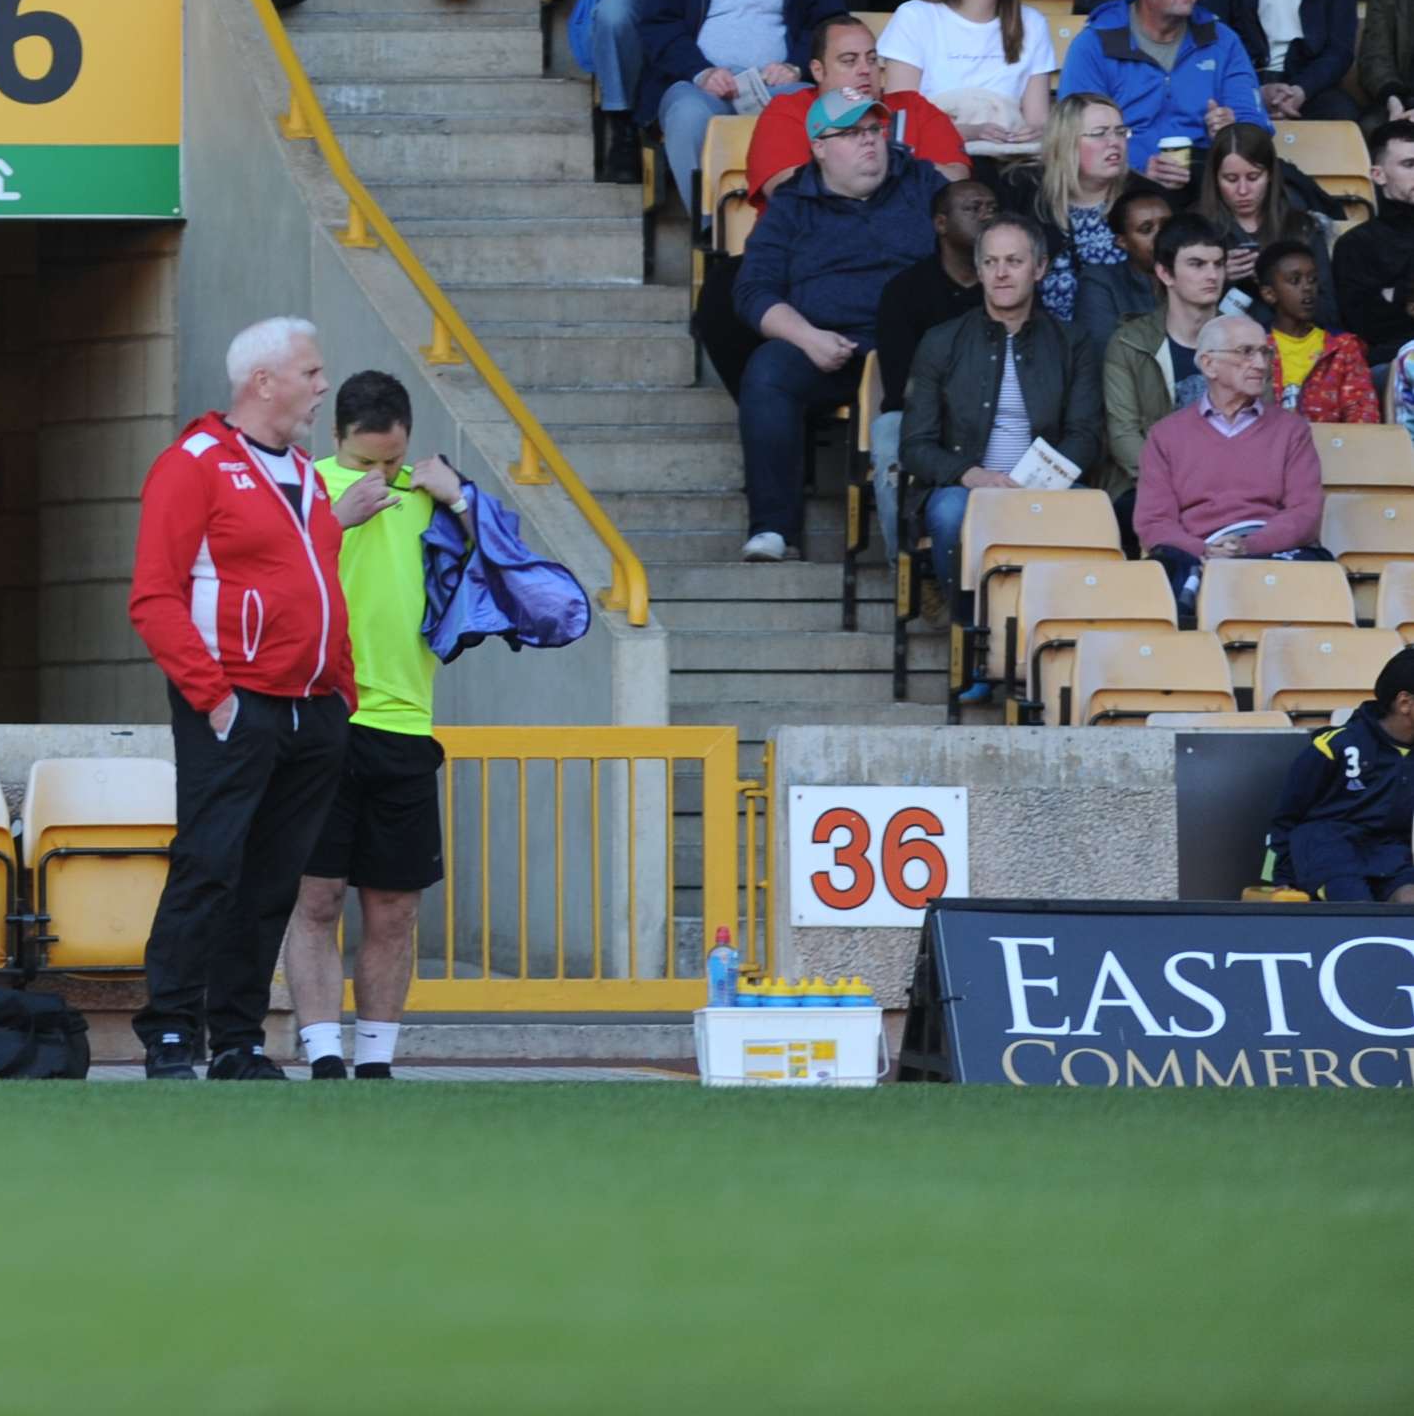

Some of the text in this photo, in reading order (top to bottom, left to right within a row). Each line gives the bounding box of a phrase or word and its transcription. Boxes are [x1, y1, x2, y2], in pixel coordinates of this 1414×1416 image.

[230, 473, 258, 490] LA
[1344, 746, 1361, 778] 3
[810, 806, 949, 911] 36
